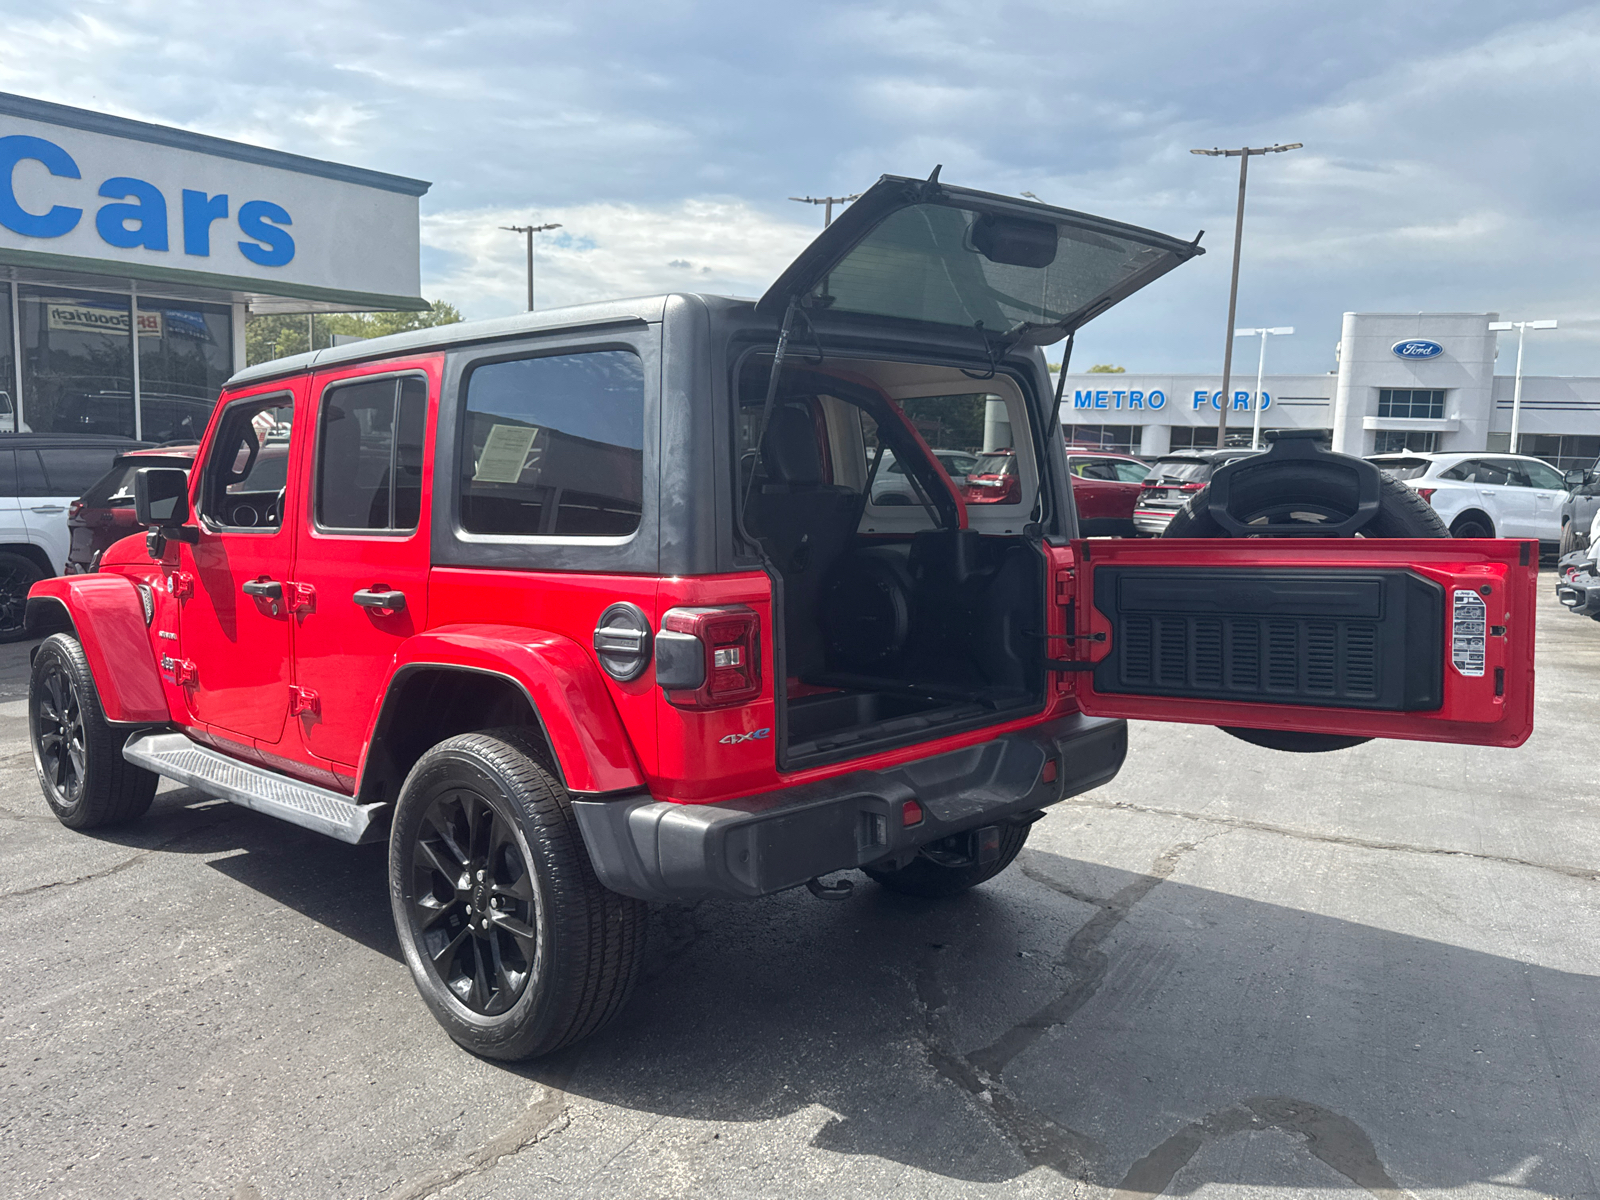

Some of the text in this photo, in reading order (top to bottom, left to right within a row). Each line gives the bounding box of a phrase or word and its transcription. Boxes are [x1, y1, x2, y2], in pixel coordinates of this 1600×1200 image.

[0, 134, 296, 267] Cars
[1402, 343, 1434, 355] Ford
[1073, 389, 1271, 411] METRO FORD
